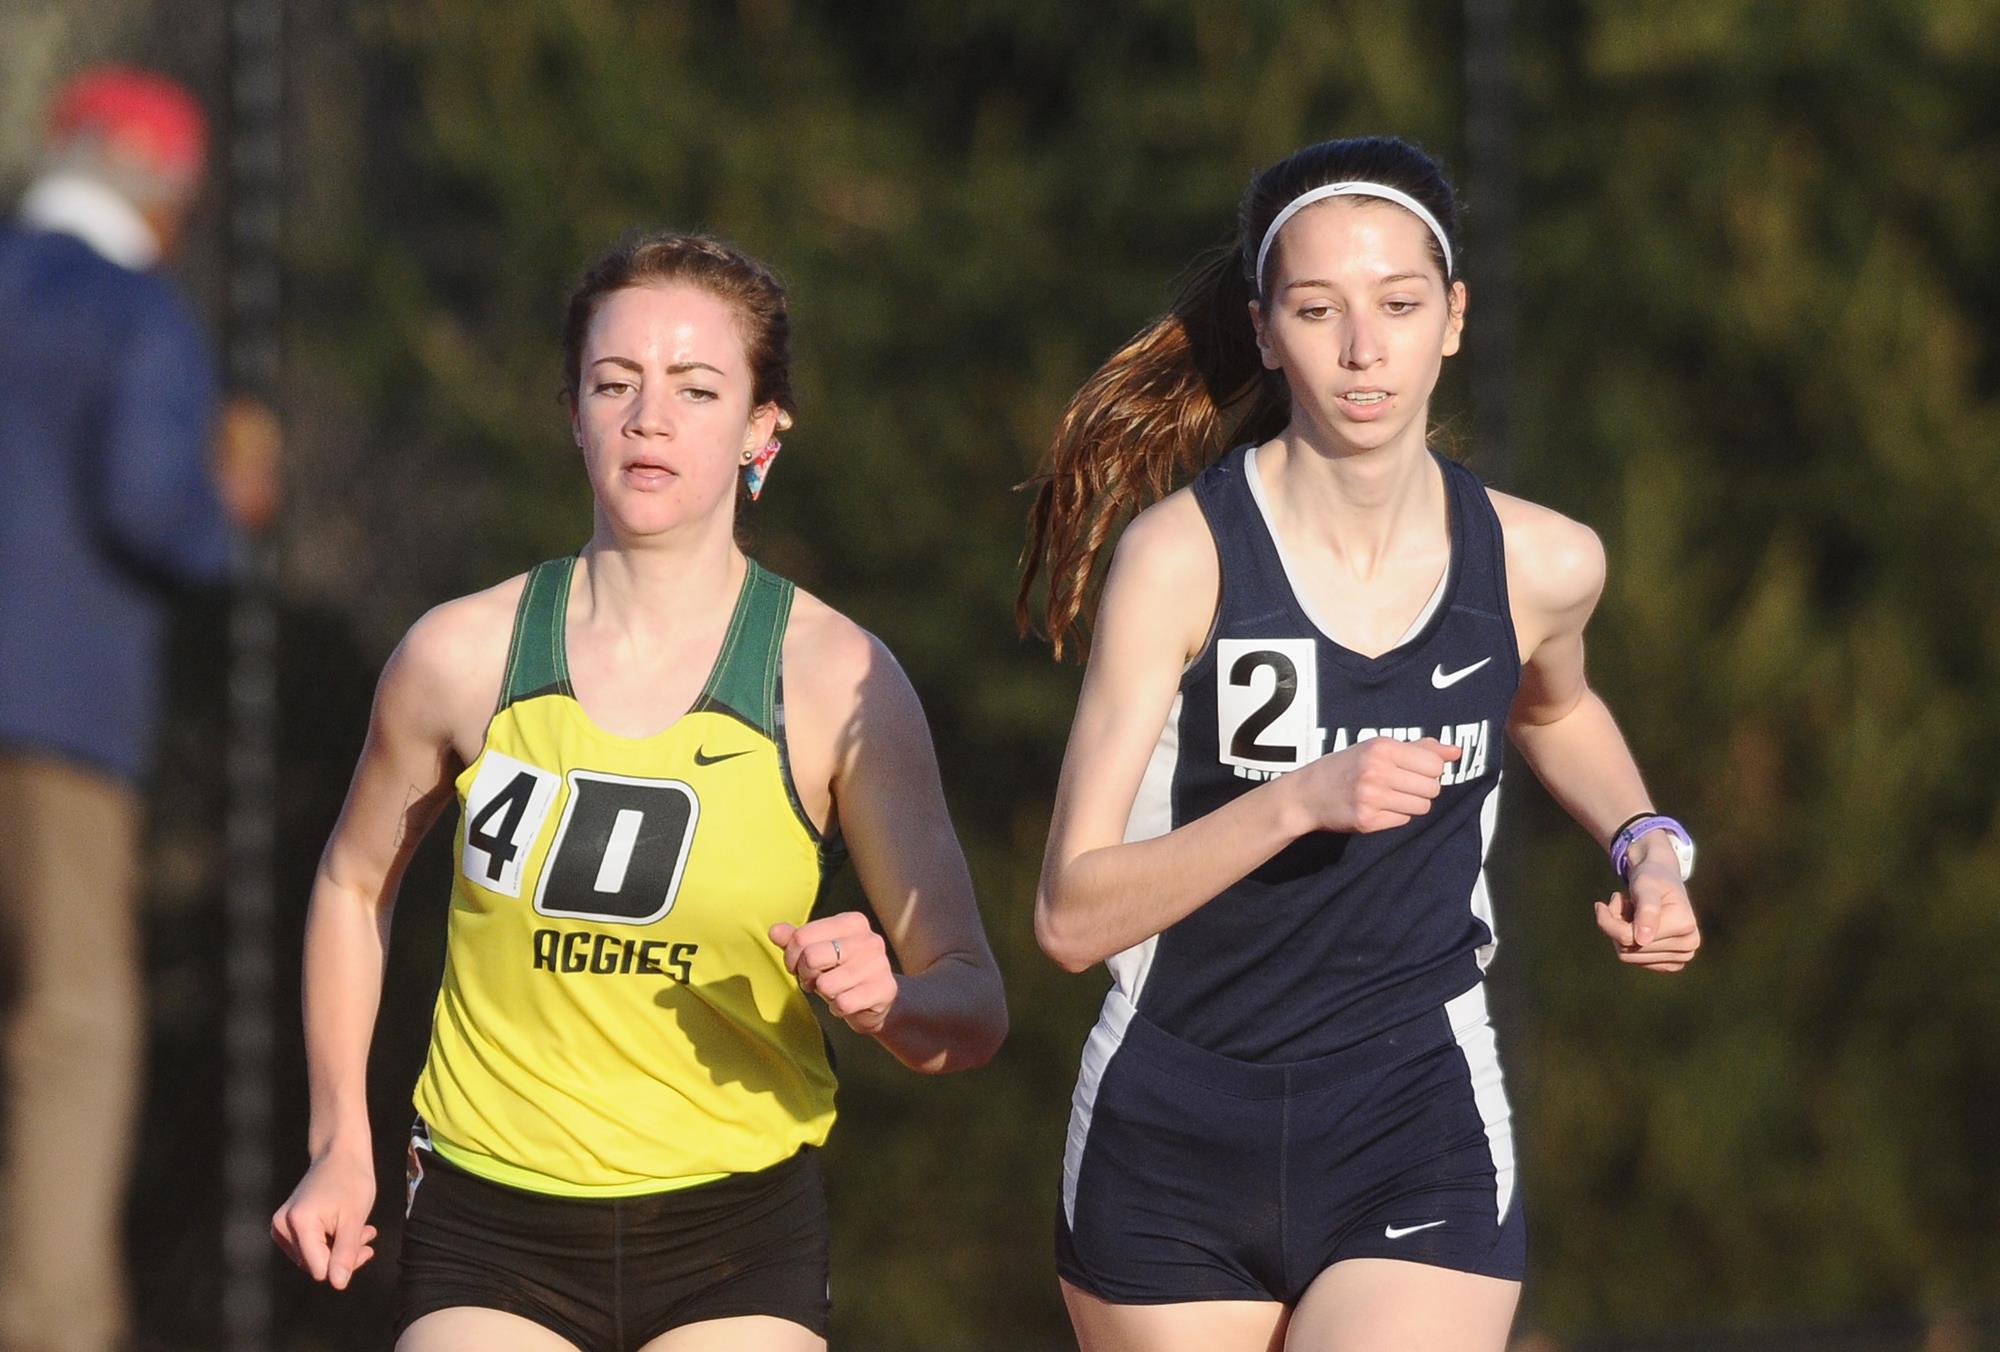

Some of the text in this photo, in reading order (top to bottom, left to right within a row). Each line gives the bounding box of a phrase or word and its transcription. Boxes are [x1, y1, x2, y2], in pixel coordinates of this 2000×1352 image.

[1229, 650, 1297, 763] 2
[469, 771, 538, 882] 4
[532, 768, 700, 926] D
[533, 929, 699, 984] AGGIES
